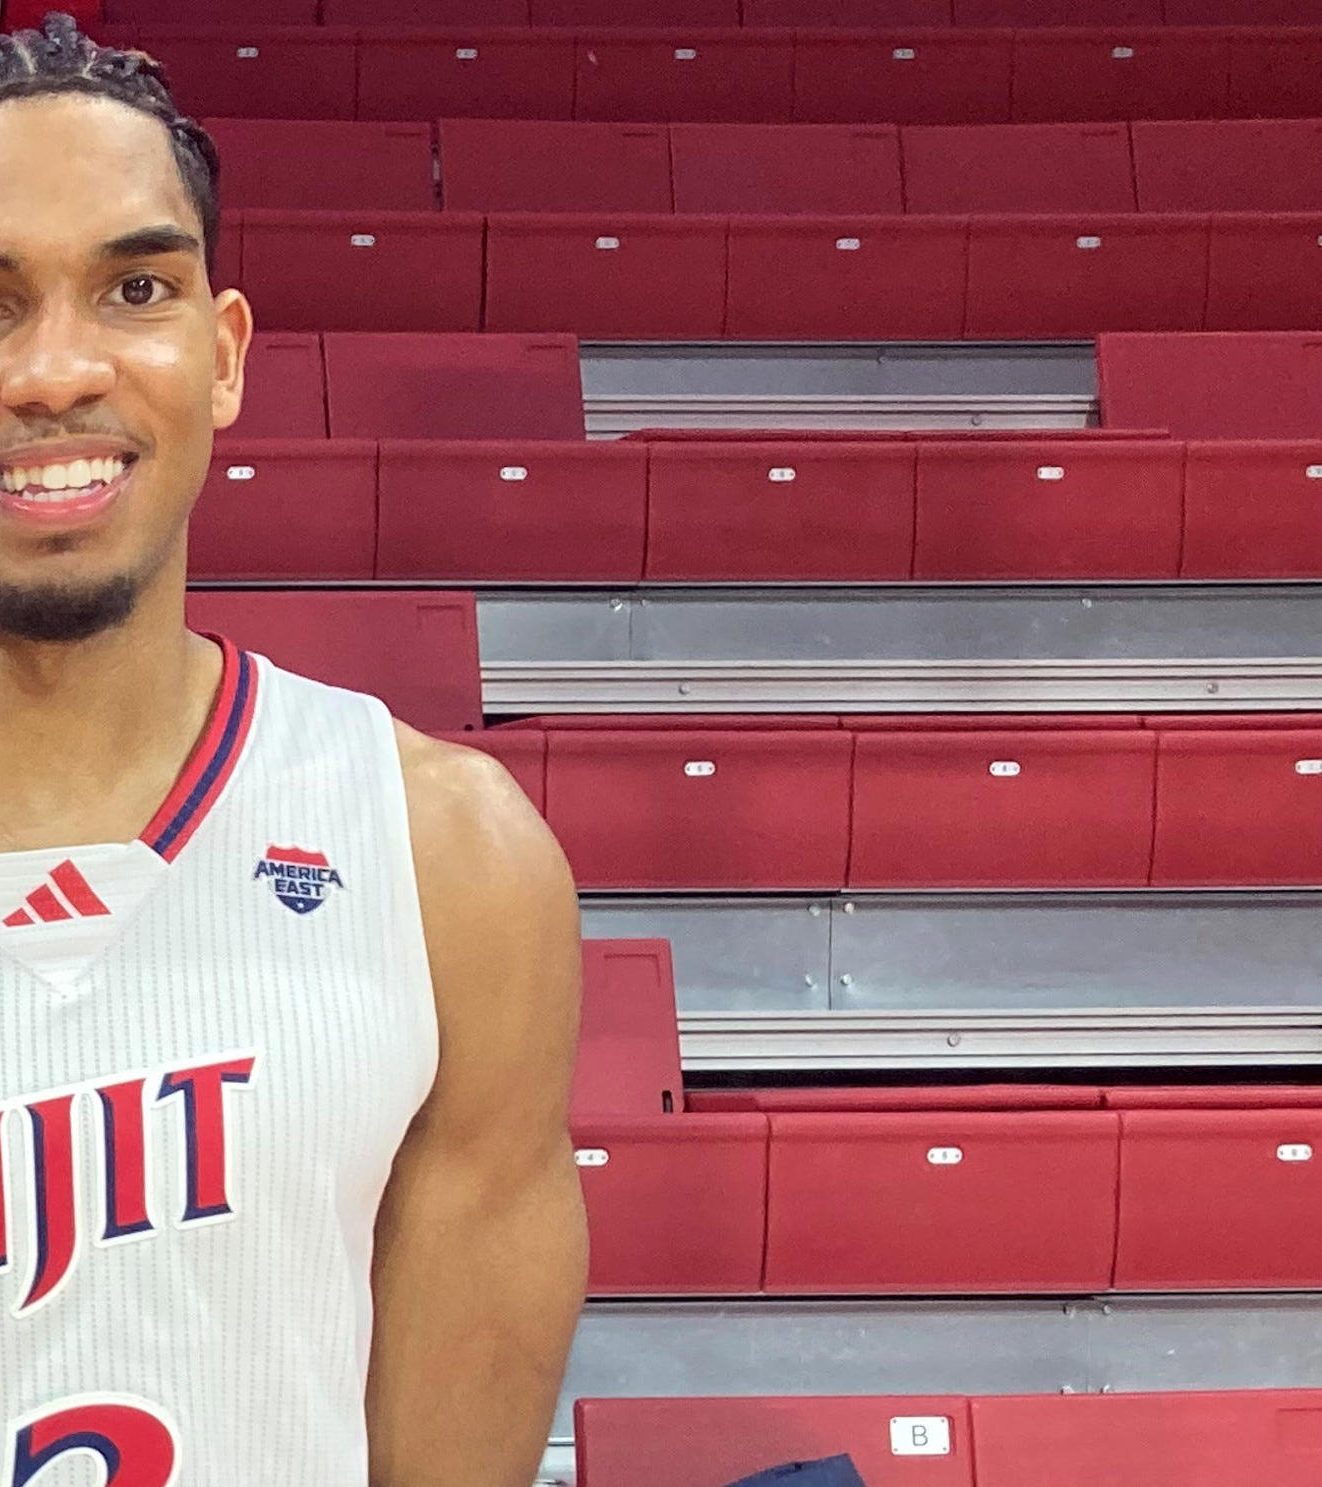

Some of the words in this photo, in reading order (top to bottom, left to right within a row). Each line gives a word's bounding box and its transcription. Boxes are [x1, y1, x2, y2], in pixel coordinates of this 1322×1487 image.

[254, 860, 345, 889] AMERICA
[274, 878, 324, 897] EAST
[911, 1425, 929, 1447] B
